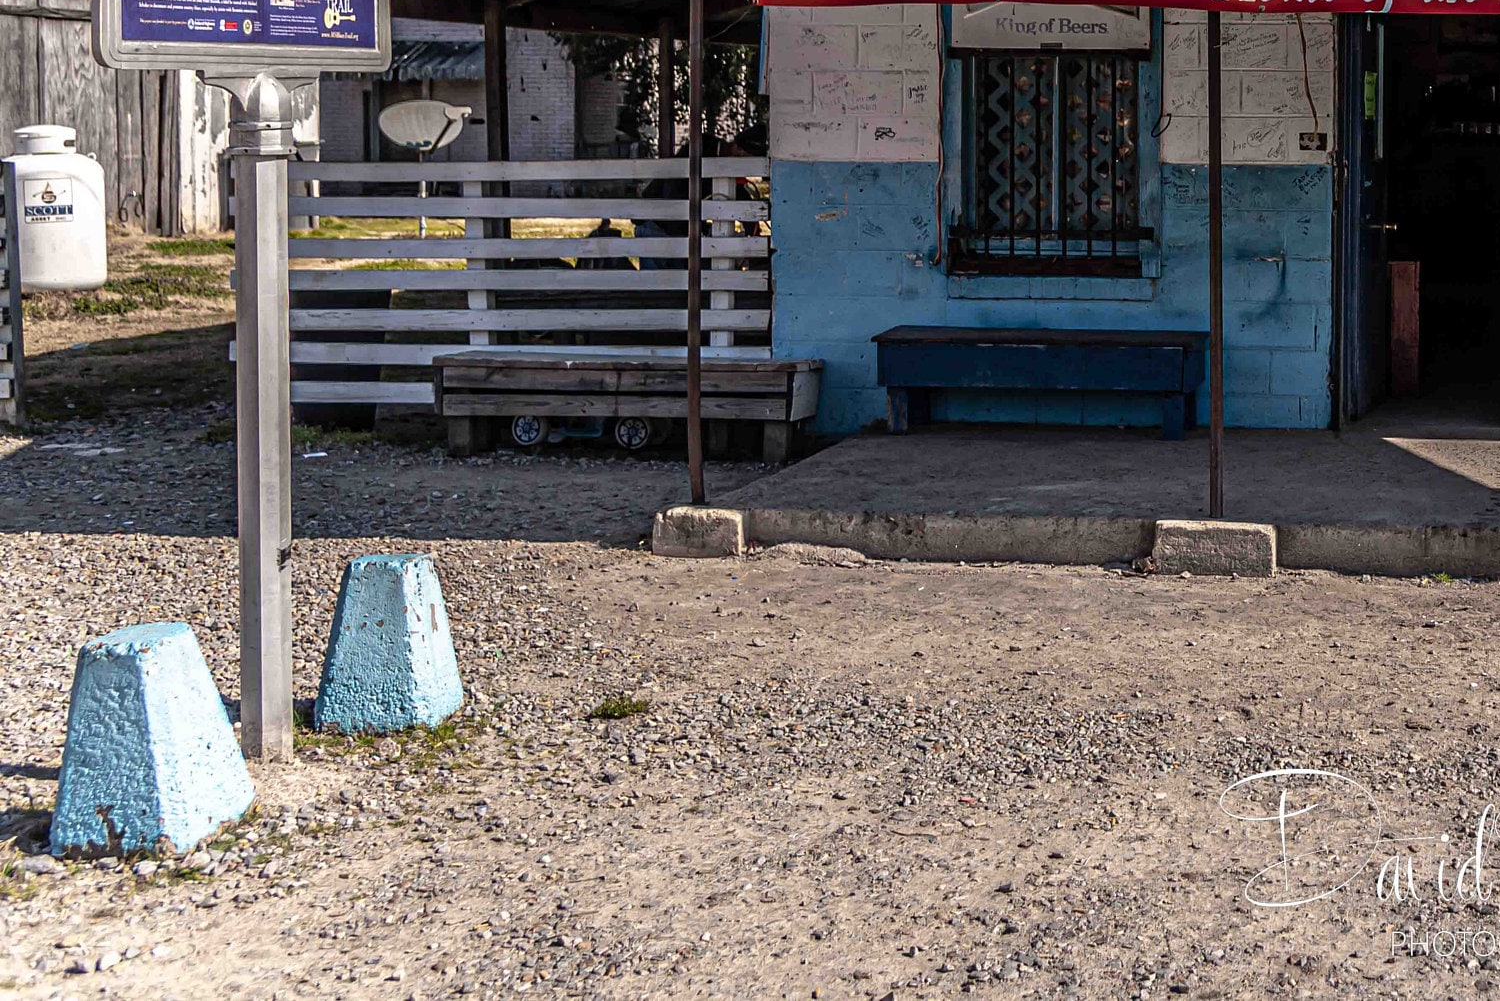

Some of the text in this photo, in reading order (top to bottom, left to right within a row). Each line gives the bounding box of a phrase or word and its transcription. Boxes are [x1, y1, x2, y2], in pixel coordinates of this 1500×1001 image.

[1039, 18, 1055, 34] of
[1059, 18, 1108, 34] Beers
[26, 205, 73, 216] SCOTT
